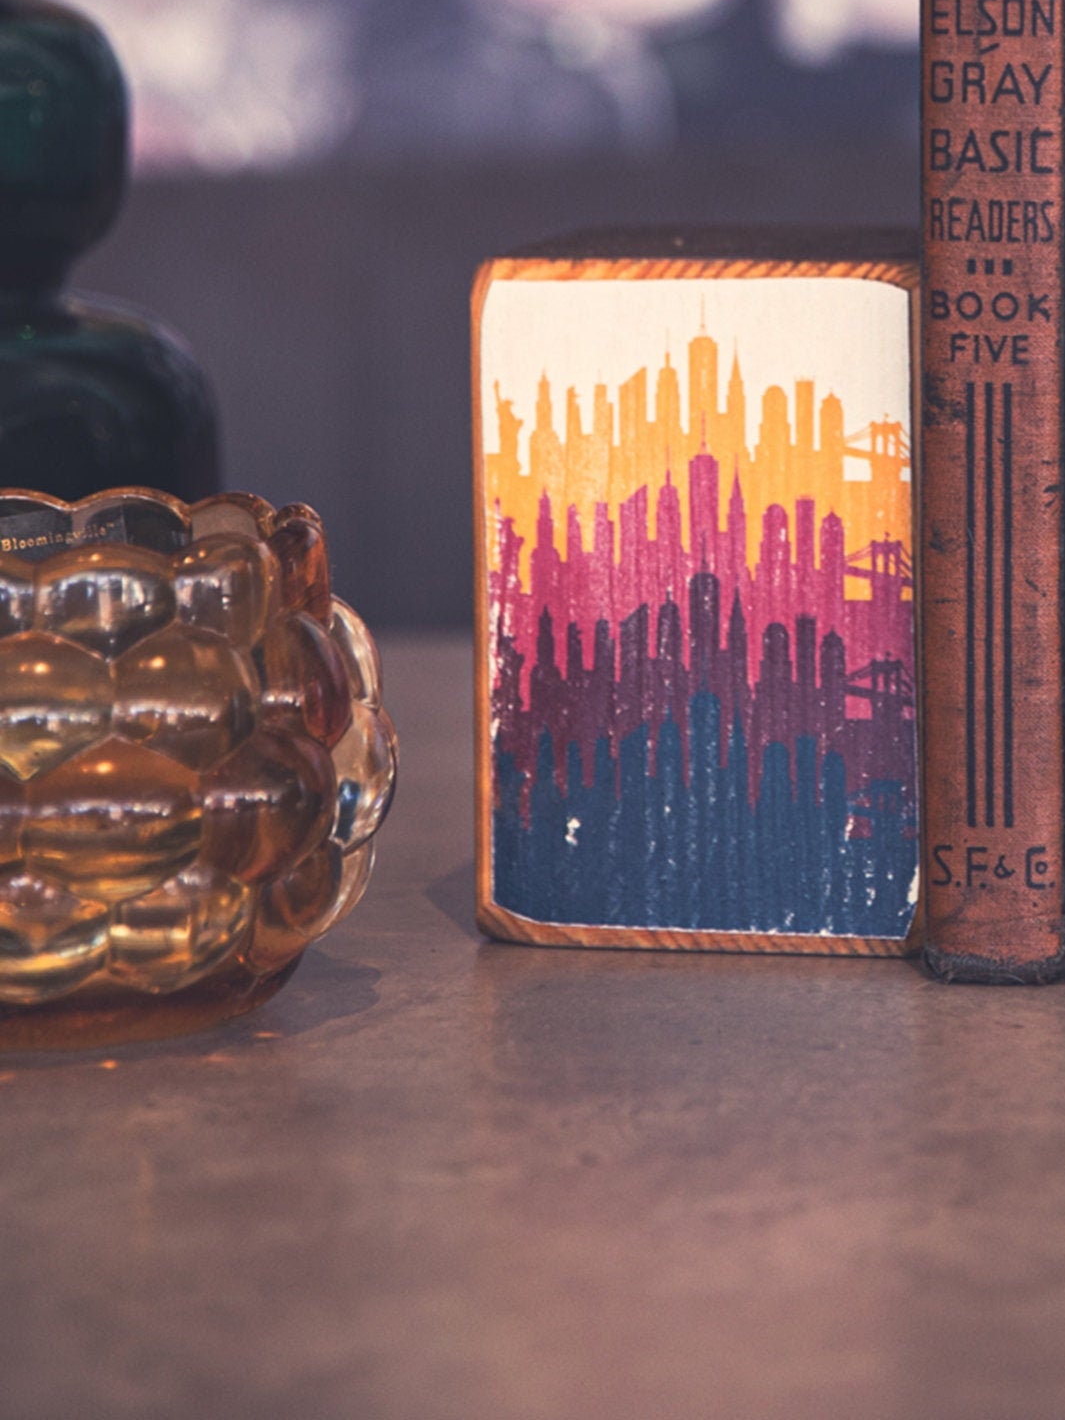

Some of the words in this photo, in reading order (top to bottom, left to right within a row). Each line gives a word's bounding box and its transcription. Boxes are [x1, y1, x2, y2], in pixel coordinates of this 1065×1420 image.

[929, 60, 1053, 106] GRAY
[929, 127, 1054, 174] BASIC
[929, 197, 1055, 243] READERS
[930, 290, 1052, 322] BOOK
[949, 332, 1030, 365] FIVE
